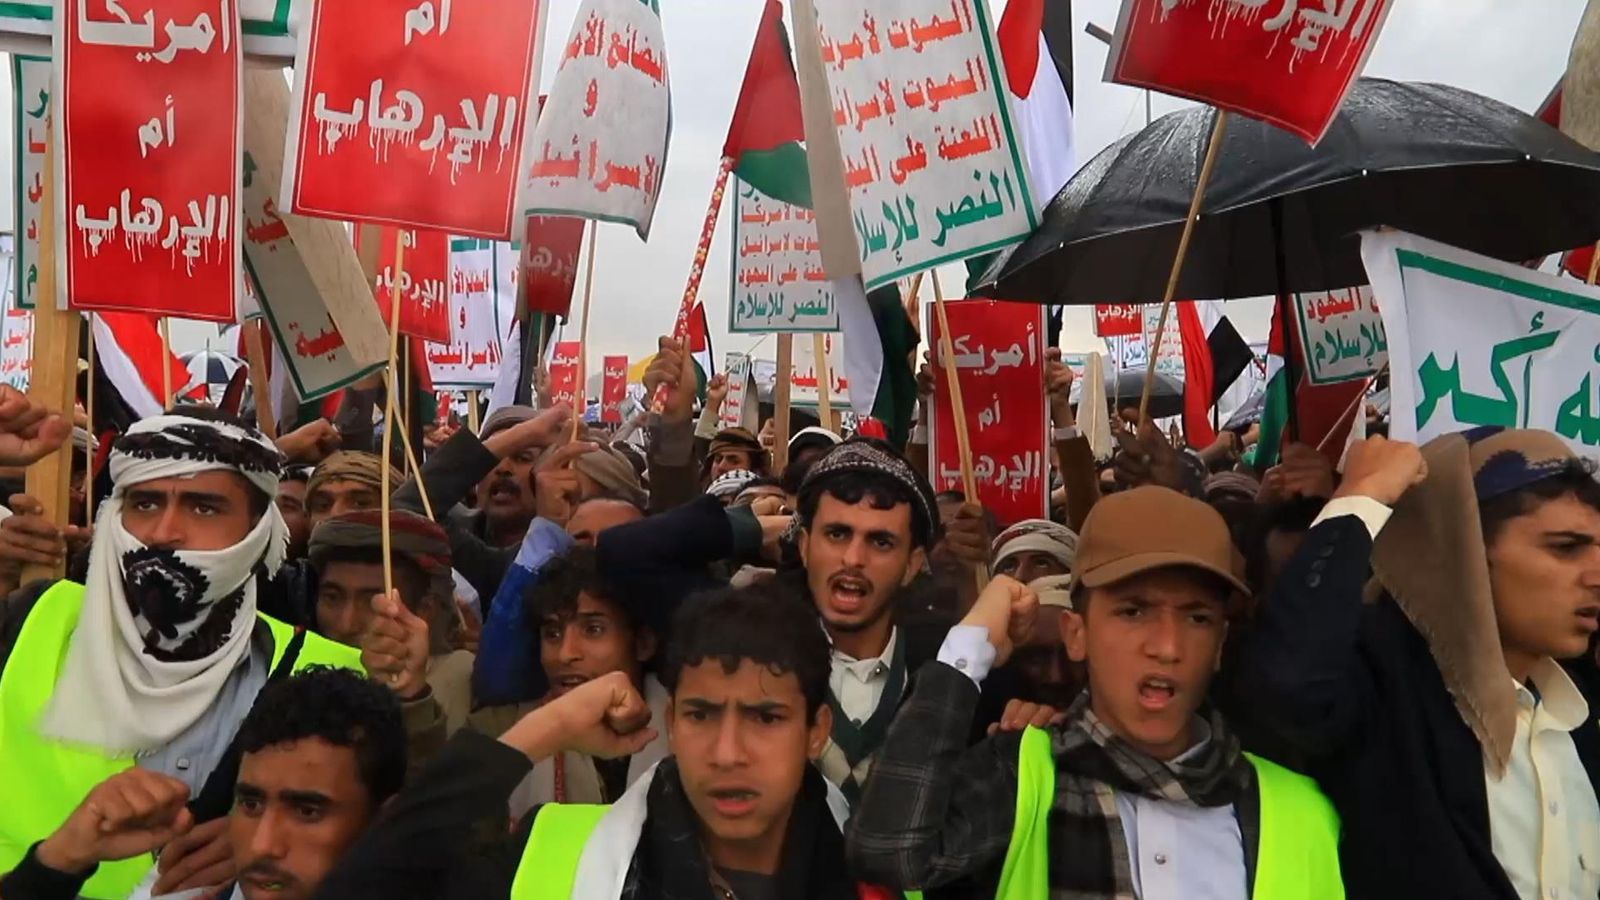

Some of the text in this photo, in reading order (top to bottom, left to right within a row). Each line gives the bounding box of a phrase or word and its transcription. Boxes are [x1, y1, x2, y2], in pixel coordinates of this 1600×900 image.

[887, 0, 972, 53] الموت
[583, 78, 598, 118] و
[903, 54, 987, 112] الموت
[138, 94, 175, 159] أم
[314, 79, 517, 178] الإرهاب
[934, 112, 1002, 161] اللعنة
[889, 134, 927, 185] على
[76, 188, 229, 266] الإرهاب
[853, 167, 1016, 265] النصر للإسلا
[736, 288, 835, 325] النصر للإسلام
[1415, 310, 1560, 432] أكبر
[978, 392, 1001, 431] أم
[940, 451, 1041, 493] الإرهب
